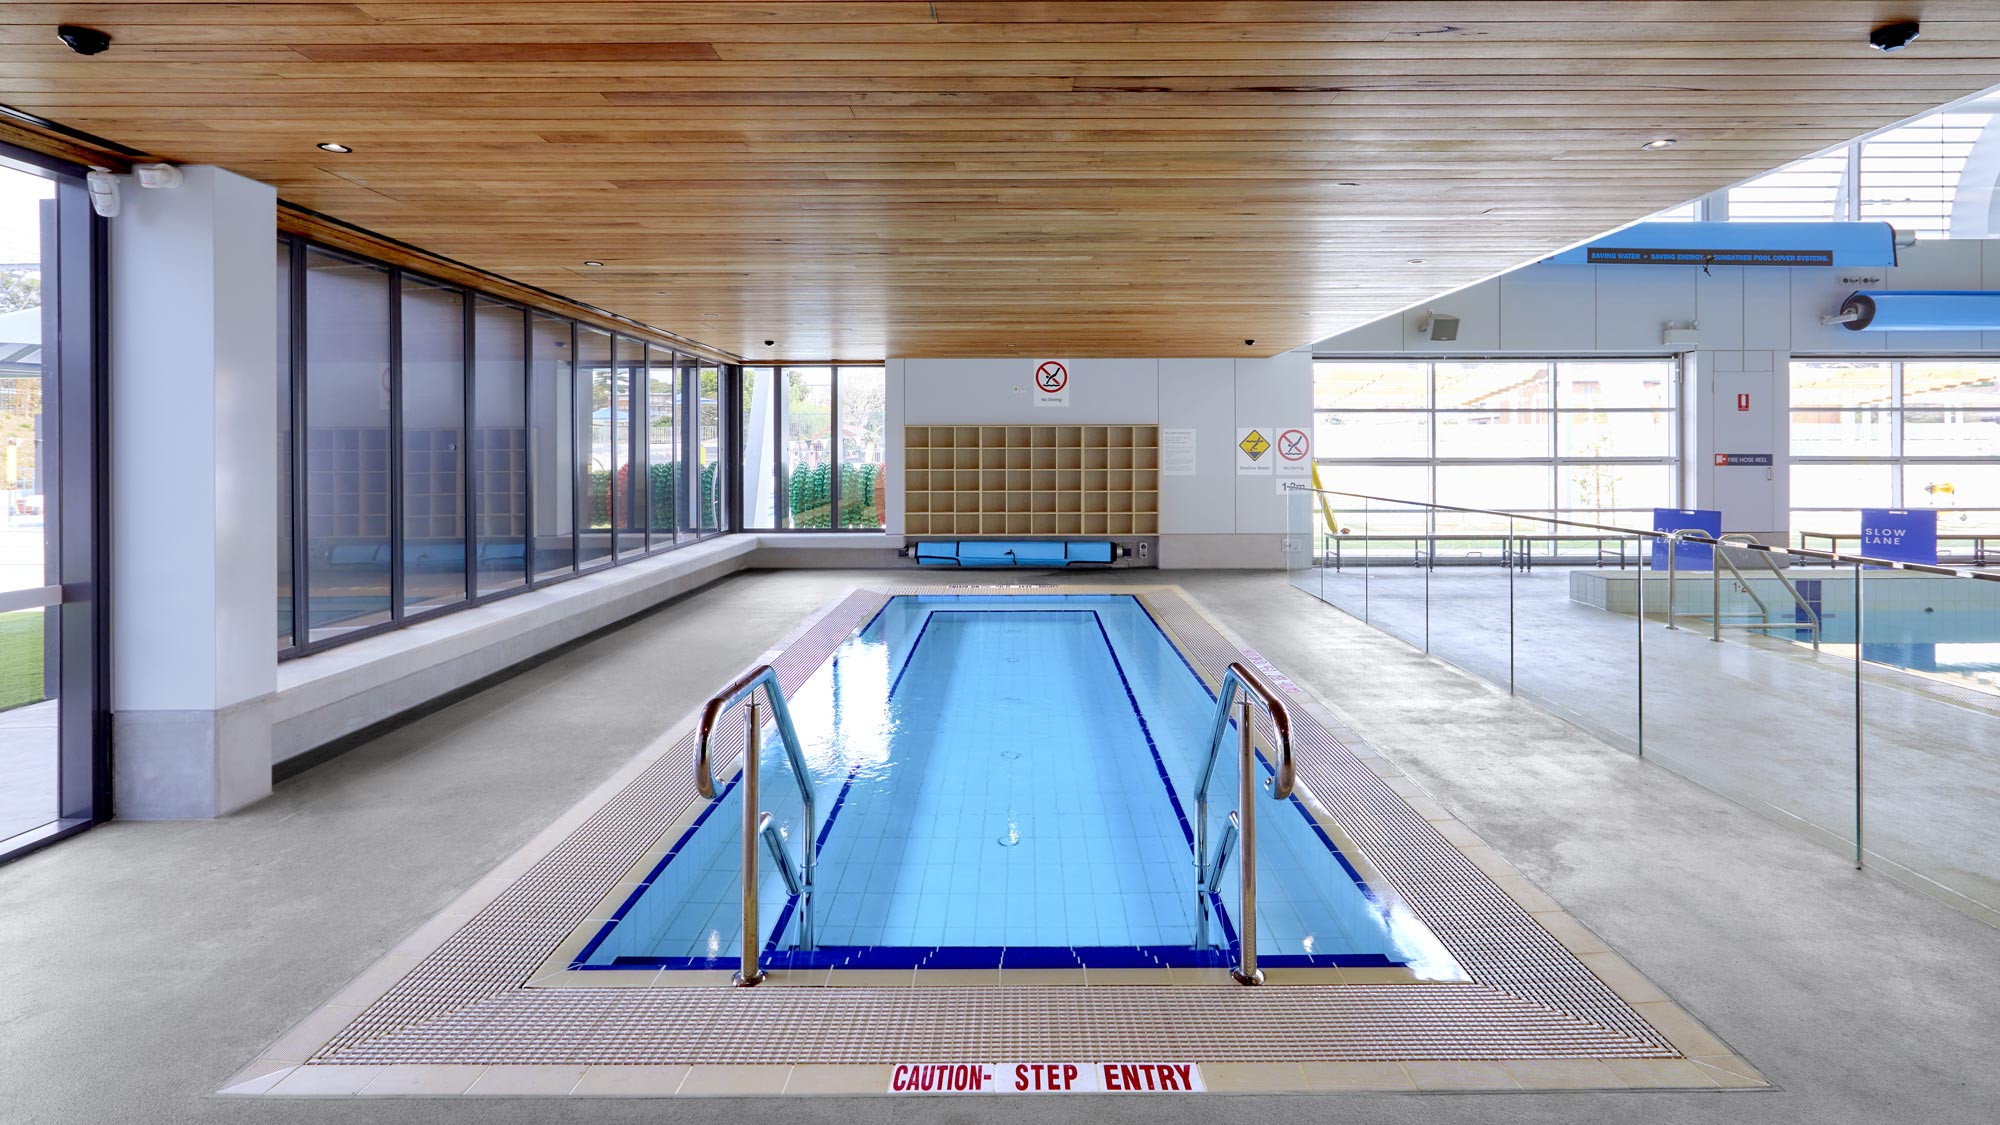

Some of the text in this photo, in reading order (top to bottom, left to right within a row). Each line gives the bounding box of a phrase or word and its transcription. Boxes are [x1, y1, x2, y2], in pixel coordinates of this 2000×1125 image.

[1865, 527, 1906, 537] SLOW
[1865, 536, 1901, 545] LANE
[1015, 1064, 1078, 1091] STEP
[1104, 1064, 1194, 1091] ENTRY
